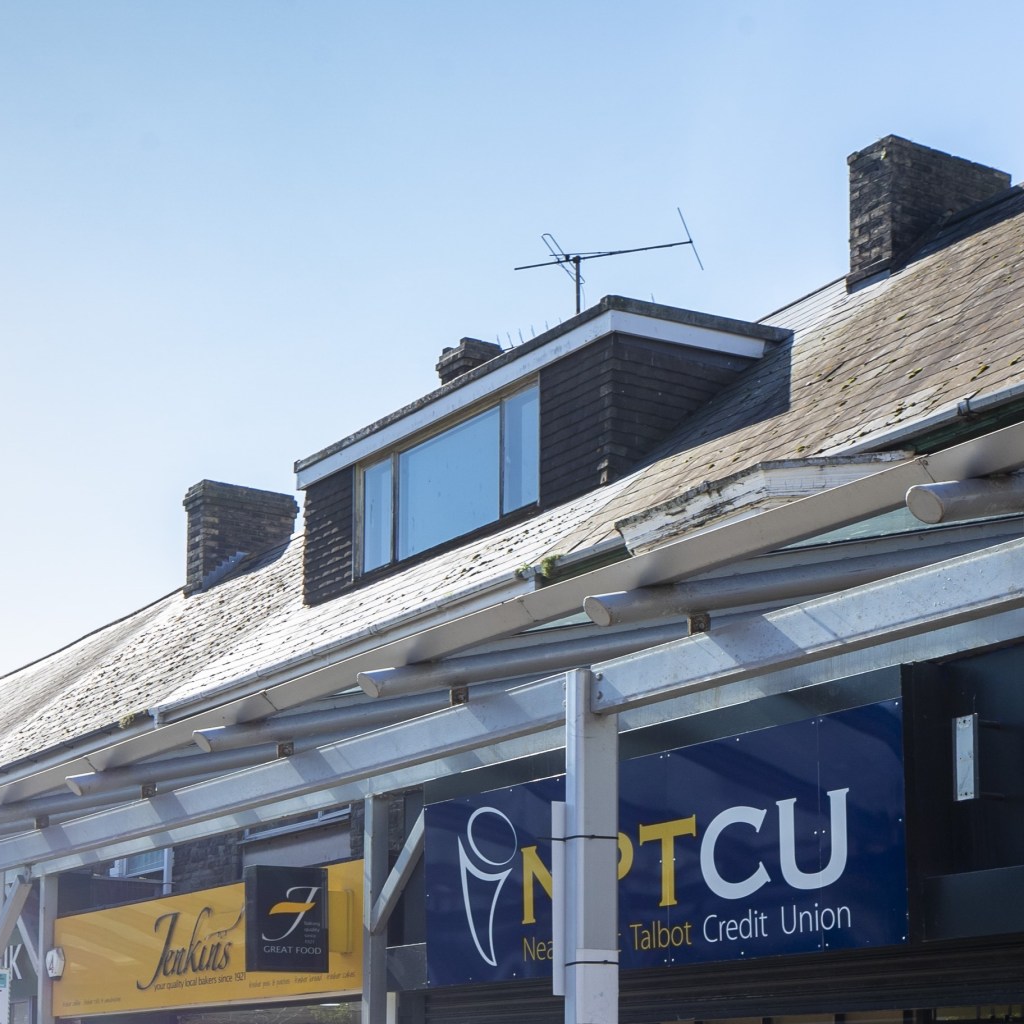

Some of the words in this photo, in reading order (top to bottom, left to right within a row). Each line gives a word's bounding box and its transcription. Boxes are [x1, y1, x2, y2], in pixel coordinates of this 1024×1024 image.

[136, 906, 234, 991] Jenkins
[263, 945, 293, 954] GREAT
[295, 946, 323, 955] FOOD
[523, 936, 554, 962] Nea
[629, 919, 693, 952] Talbot
[702, 908, 769, 944] Credit
[780, 902, 852, 936] Union
[154, 981, 167, 992] your
[166, 979, 185, 991] quality
[185, 977, 198, 988] local
[198, 975, 218, 986] bakers
[218, 974, 233, 984] since
[234, 971, 246, 982] 1921
